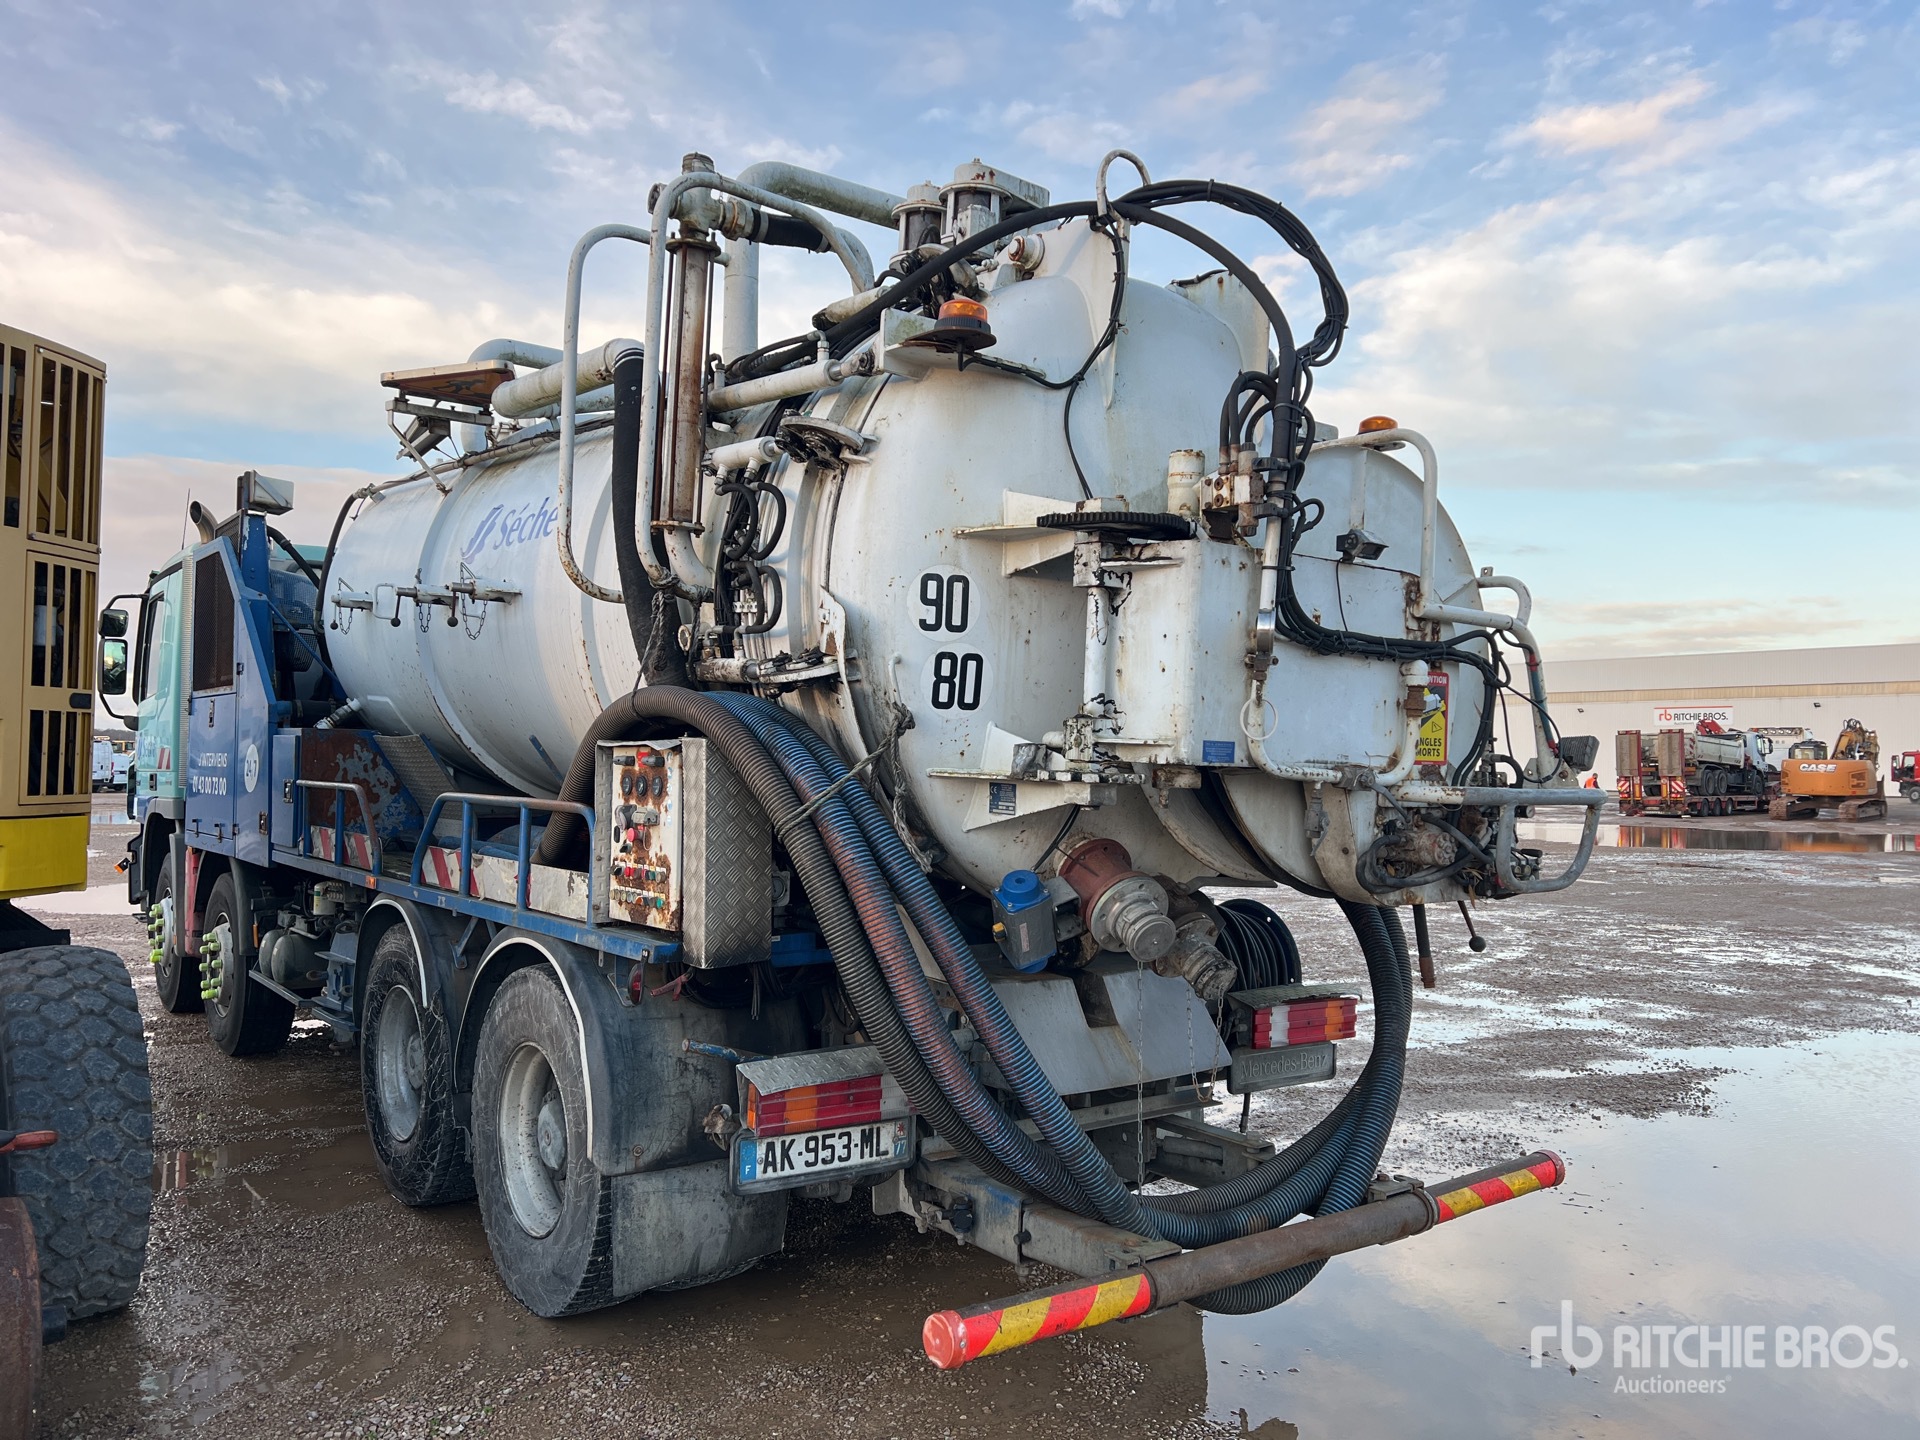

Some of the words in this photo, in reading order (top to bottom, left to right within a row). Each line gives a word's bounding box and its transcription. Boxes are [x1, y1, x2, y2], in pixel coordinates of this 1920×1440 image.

[918, 573, 970, 633] 90
[931, 651, 984, 711] 80
[1659, 709, 1672, 721] rb
[1673, 712, 1702, 721] RITCHIE
[1703, 711, 1729, 721] BROS.
[1417, 737, 1442, 747] NGLES
[1800, 763, 1837, 772] CASE
[1240, 1052, 1329, 1079] Mercedes-Benz
[745, 1165, 752, 1175] F
[762, 1126, 889, 1174] AK-953-ML
[894, 1139, 907, 1155] 77
